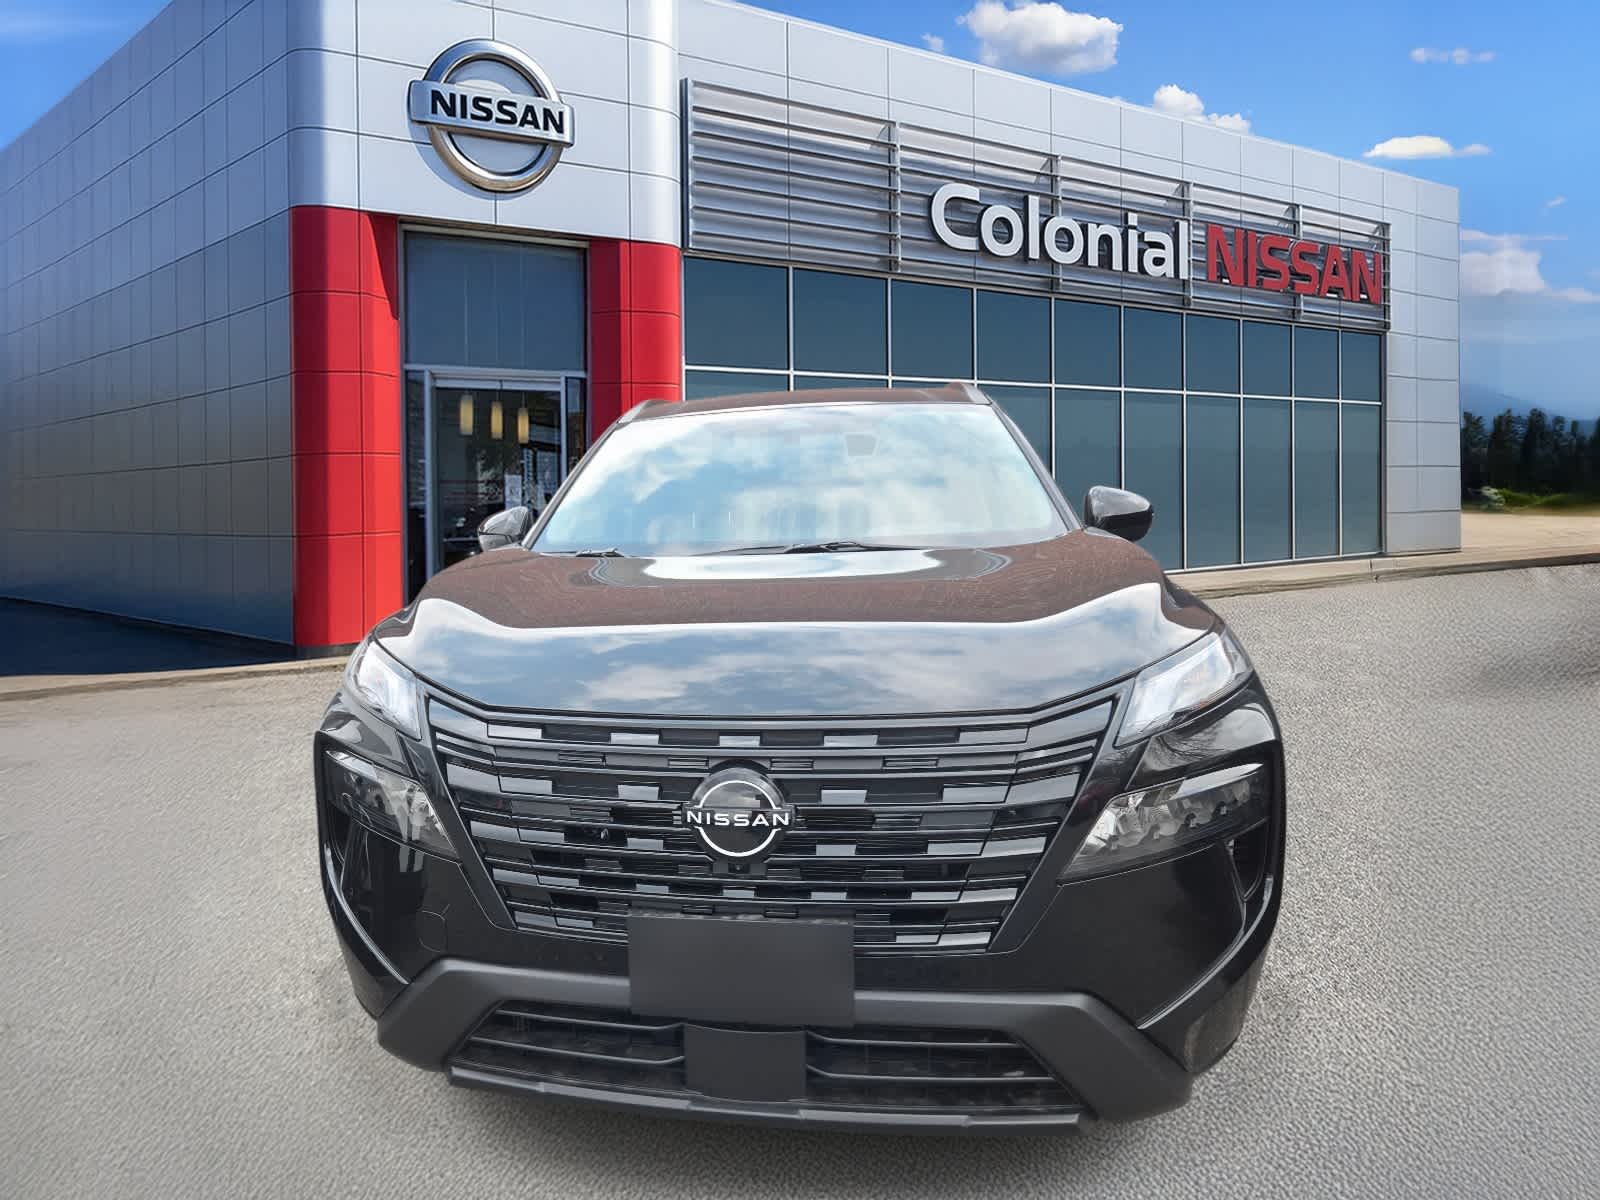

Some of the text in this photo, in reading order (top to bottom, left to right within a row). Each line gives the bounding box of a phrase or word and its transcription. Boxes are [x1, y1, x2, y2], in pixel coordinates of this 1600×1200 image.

[430, 89, 565, 134] NISSAN
[931, 183, 1383, 304] Colonial NISSAN
[686, 810, 790, 827] NISSAN
